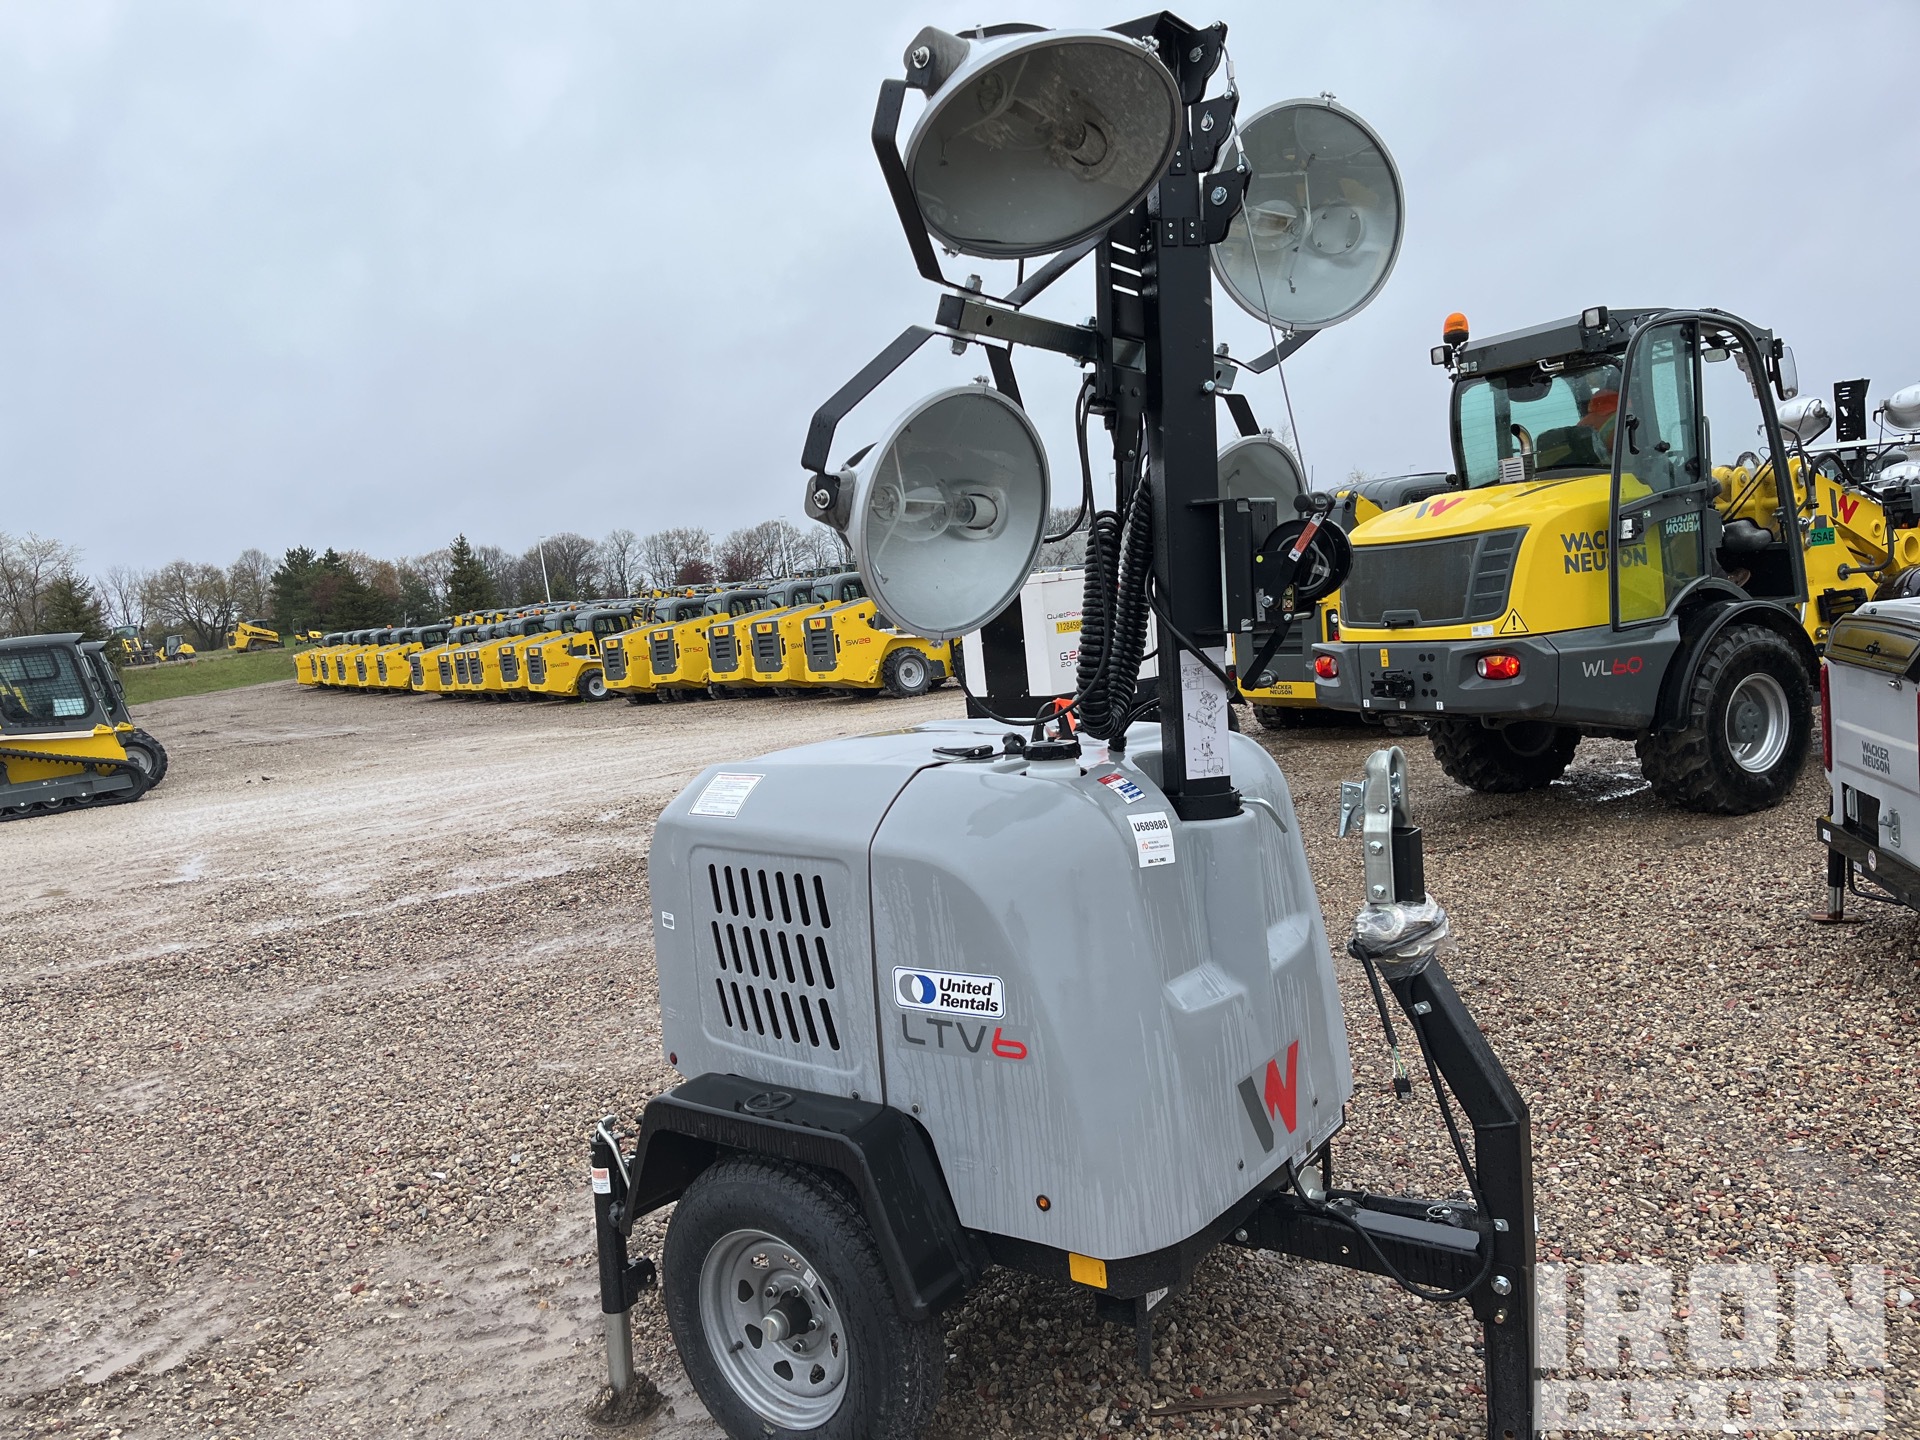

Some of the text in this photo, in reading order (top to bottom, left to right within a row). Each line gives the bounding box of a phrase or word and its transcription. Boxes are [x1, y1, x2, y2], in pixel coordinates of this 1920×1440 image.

[1560, 530, 1609, 553] WAC
[1811, 530, 1834, 543] ZSAE
[1563, 546, 1648, 575] NEUON
[1046, 611, 1082, 620] QuietPow
[845, 637, 871, 646] SW28
[1581, 656, 1644, 678] WL60
[1861, 740, 1890, 762] WACKER
[1862, 753, 1891, 775] NEUSON
[1133, 819, 1169, 832] U689888
[939, 977, 993, 996] United
[939, 993, 999, 1012] Rentals
[901, 1013, 1028, 1060] LTV6
